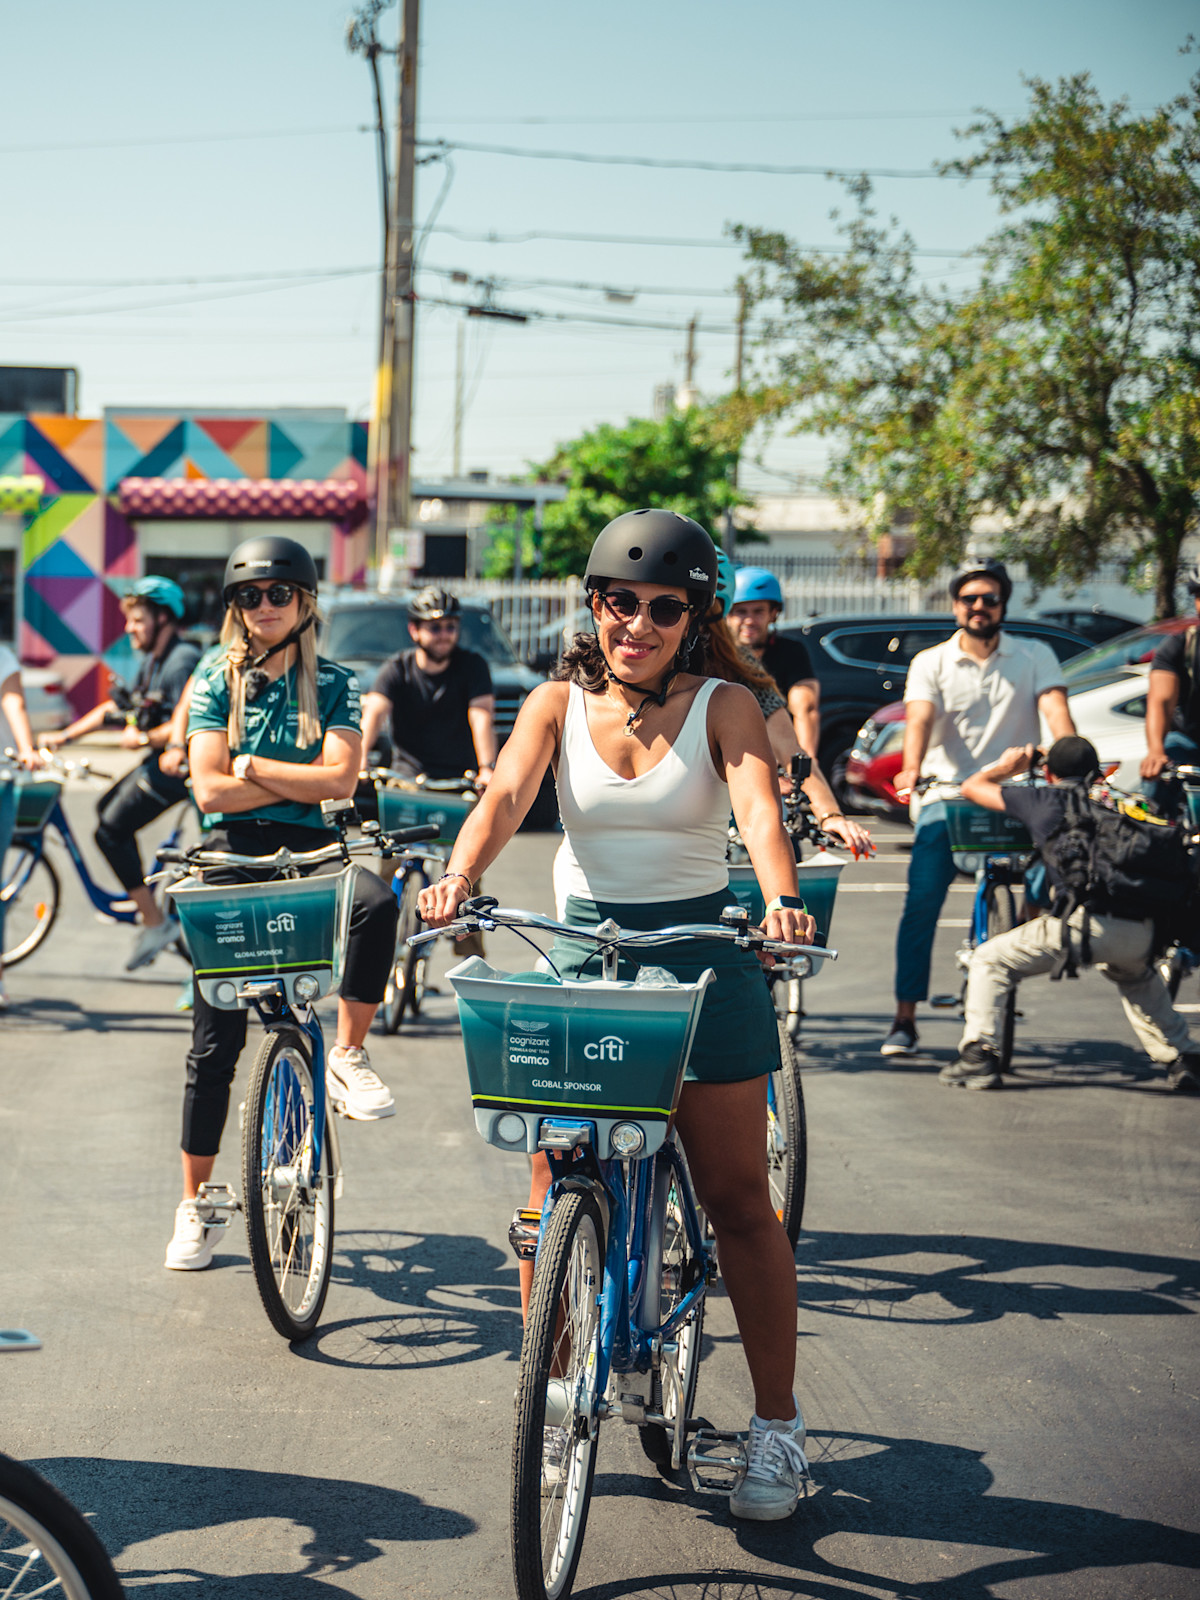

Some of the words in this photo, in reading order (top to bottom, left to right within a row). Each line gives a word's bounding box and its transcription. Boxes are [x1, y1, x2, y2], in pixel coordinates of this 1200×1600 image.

[215, 922, 244, 931] cognizant
[266, 912, 295, 933] citi
[216, 935, 246, 944] aramco
[234, 950, 256, 959] GLOBAL
[256, 948, 284, 958] SPONSOR
[509, 1036, 550, 1047] cognizant
[583, 1035, 625, 1061] citi
[509, 1054, 550, 1066] aramco
[531, 1079, 563, 1090] GLOBAL
[563, 1081, 602, 1092] SPONSOR
